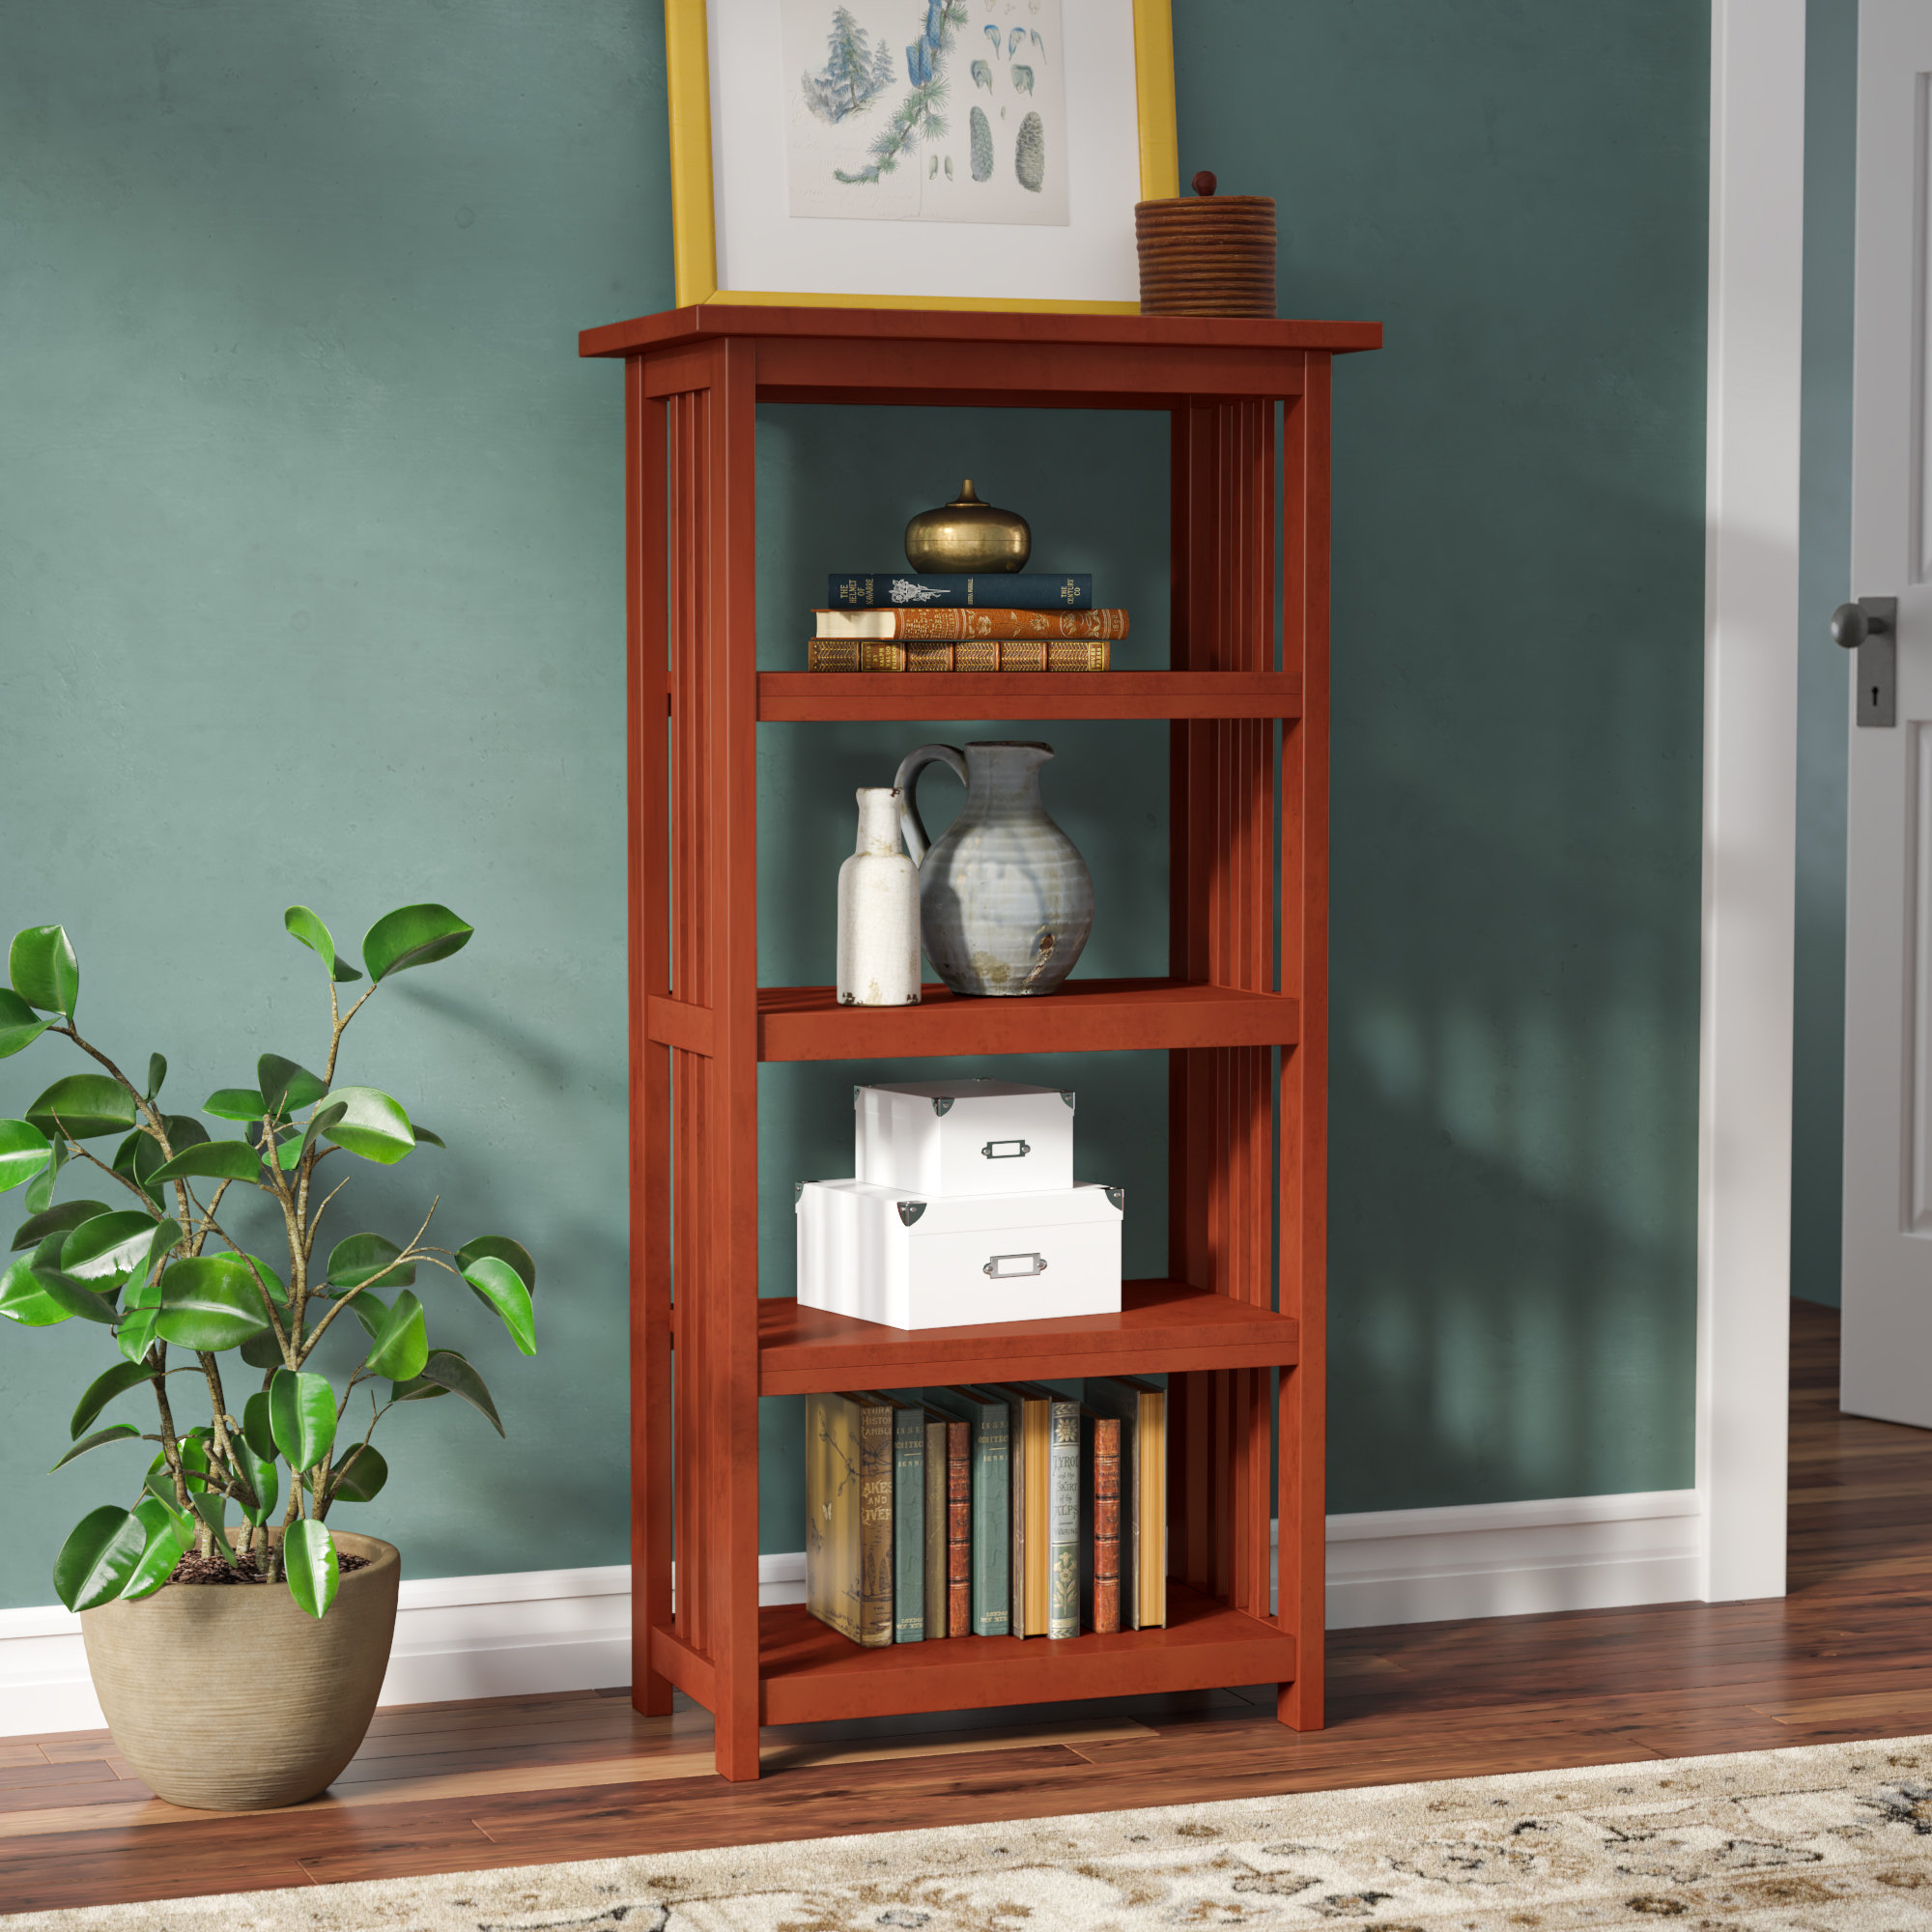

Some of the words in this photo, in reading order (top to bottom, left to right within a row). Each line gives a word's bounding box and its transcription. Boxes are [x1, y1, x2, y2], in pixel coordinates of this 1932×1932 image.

[840, 584, 849, 599] THE
[858, 587, 866, 597] OF
[862, 1479, 893, 1498] AKES
[867, 1494, 888, 1506] AND
